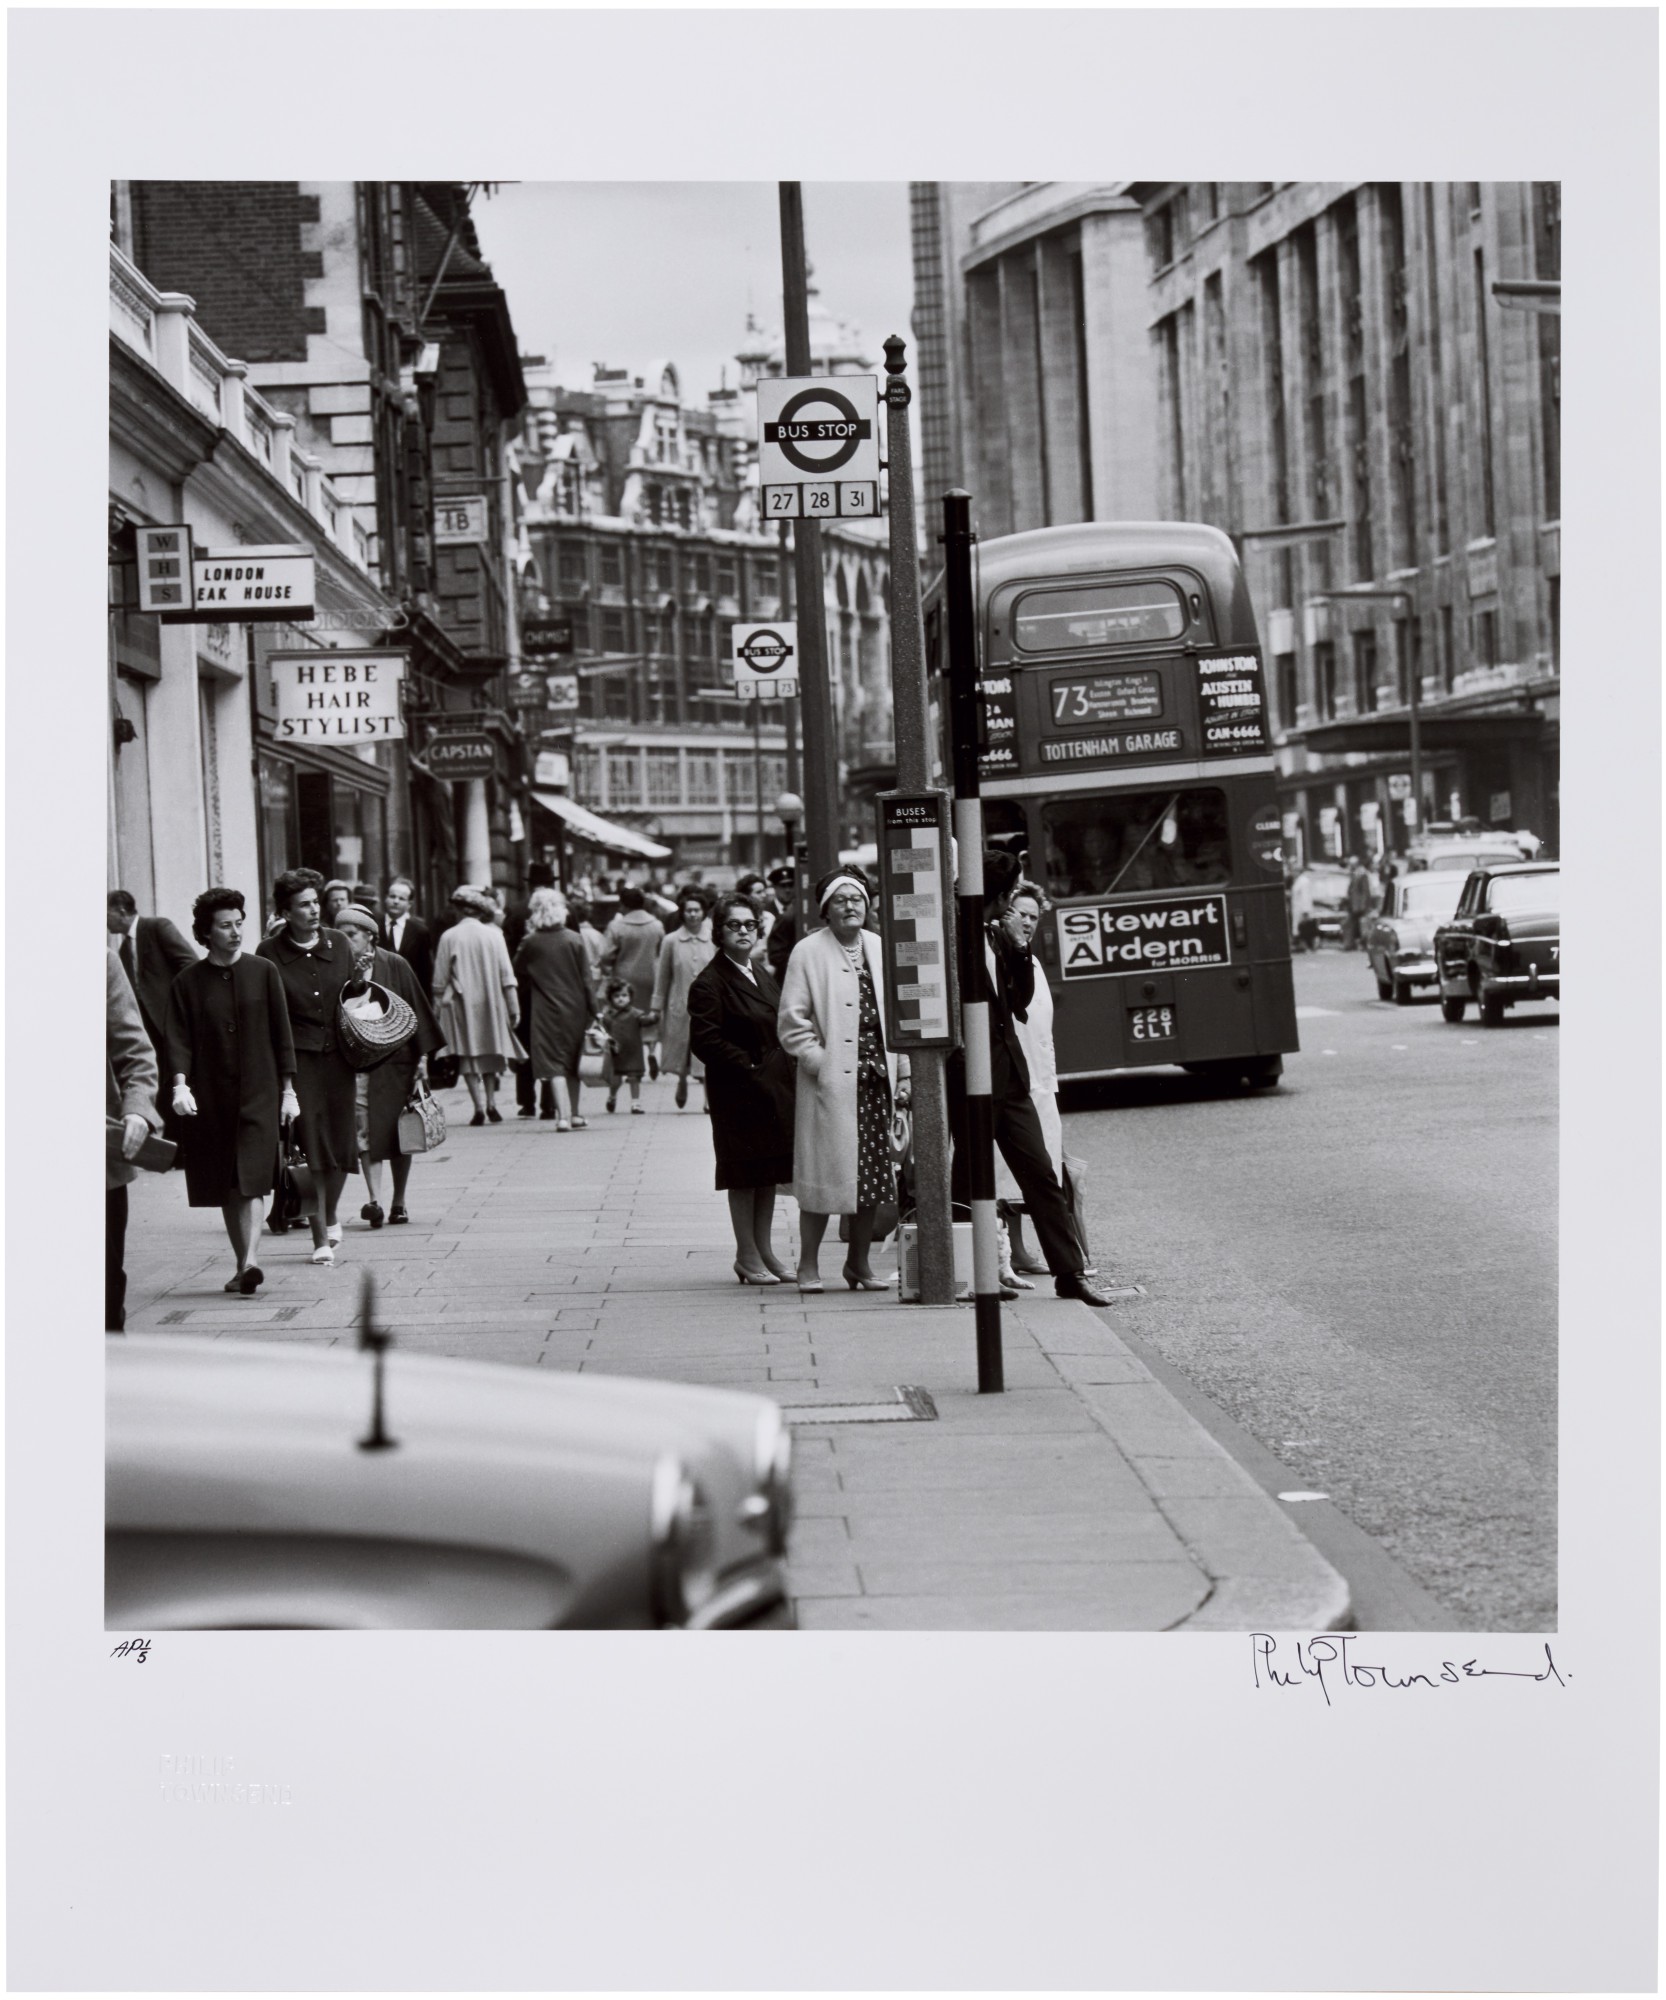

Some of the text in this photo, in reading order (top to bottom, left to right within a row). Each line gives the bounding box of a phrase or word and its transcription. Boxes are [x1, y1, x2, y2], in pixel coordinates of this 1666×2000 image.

[778, 423, 857, 439] BUS STOP
[772, 493, 794, 510] 27
[810, 492, 830, 509] 28
[850, 490, 864, 507] 31
[204, 567, 265, 581] LONDON
[244, 585, 292, 600] HOUSE
[743, 646, 787, 657] BUS STOP
[297, 665, 378, 684] HEBE
[743, 685, 751, 695] 9
[781, 683, 793, 694] 73
[1201, 680, 1253, 696] AUSTIN
[307, 691, 371, 709] HAIR
[1053, 686, 1089, 718] 73
[1217, 693, 1261, 708] HUMBER
[281, 716, 395, 736] STYLIST
[430, 744, 493, 760] CAPSTAN
[1044, 731, 1178, 760] TOTTENHAM GARAGE
[896, 807, 926, 816] BUSES
[1064, 903, 1219, 935] Stewart
[1067, 936, 1203, 965] Ardern
[1152, 953, 1222, 968] for MORRIS
[1132, 1008, 1173, 1024] 228
[1132, 1022, 1173, 1039] CLT
[159, 1753, 235, 1777] PHILIP
[159, 1782, 292, 1805] TOWNSEND
